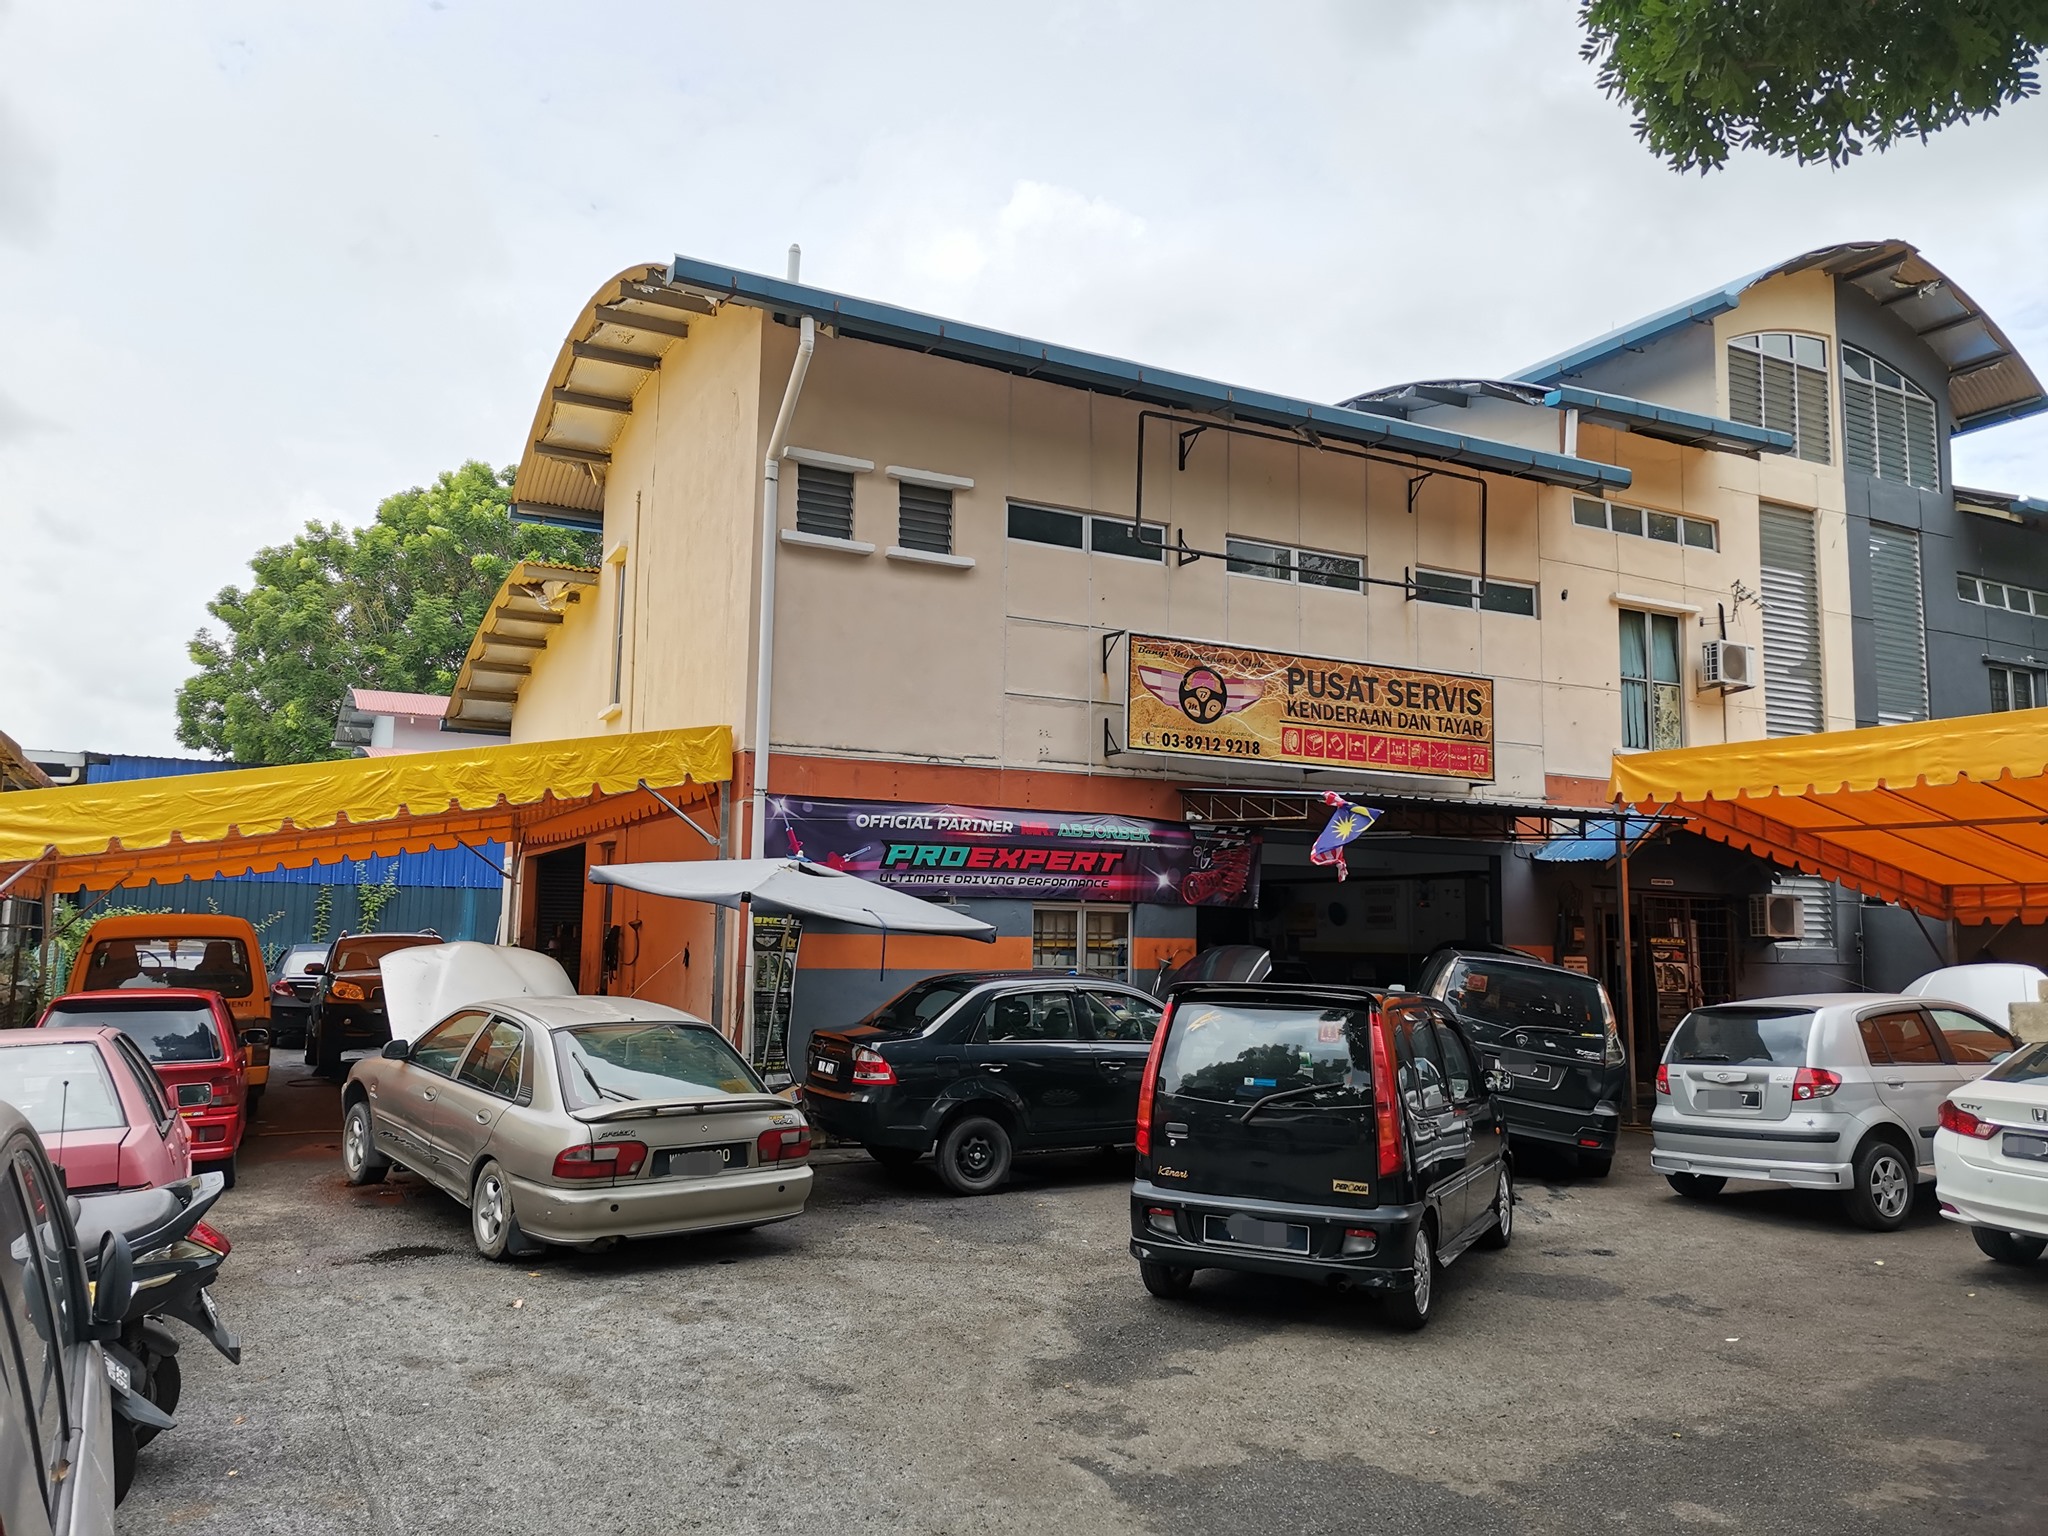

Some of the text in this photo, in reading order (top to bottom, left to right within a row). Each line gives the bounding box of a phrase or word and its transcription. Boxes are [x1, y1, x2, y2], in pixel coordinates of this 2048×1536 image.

[1138, 645, 1168, 658] Bangi
[1287, 667, 1482, 715] PUSAT SERVIS
[1287, 700, 1483, 736] KENDERAAN DAN TAYAR
[1225, 739, 1260, 755] 9218
[1472, 753, 1485, 765] 24
[855, 814, 1150, 842] OFFICIAL PARTNER MR. ABSORBER
[885, 844, 1123, 872] PROEXPERT
[879, 873, 1110, 888] ULTIMATE DRIVING PERFORMANCE
[1961, 1103, 1983, 1111] CITY
[1157, 1165, 1189, 1179] Kenari
